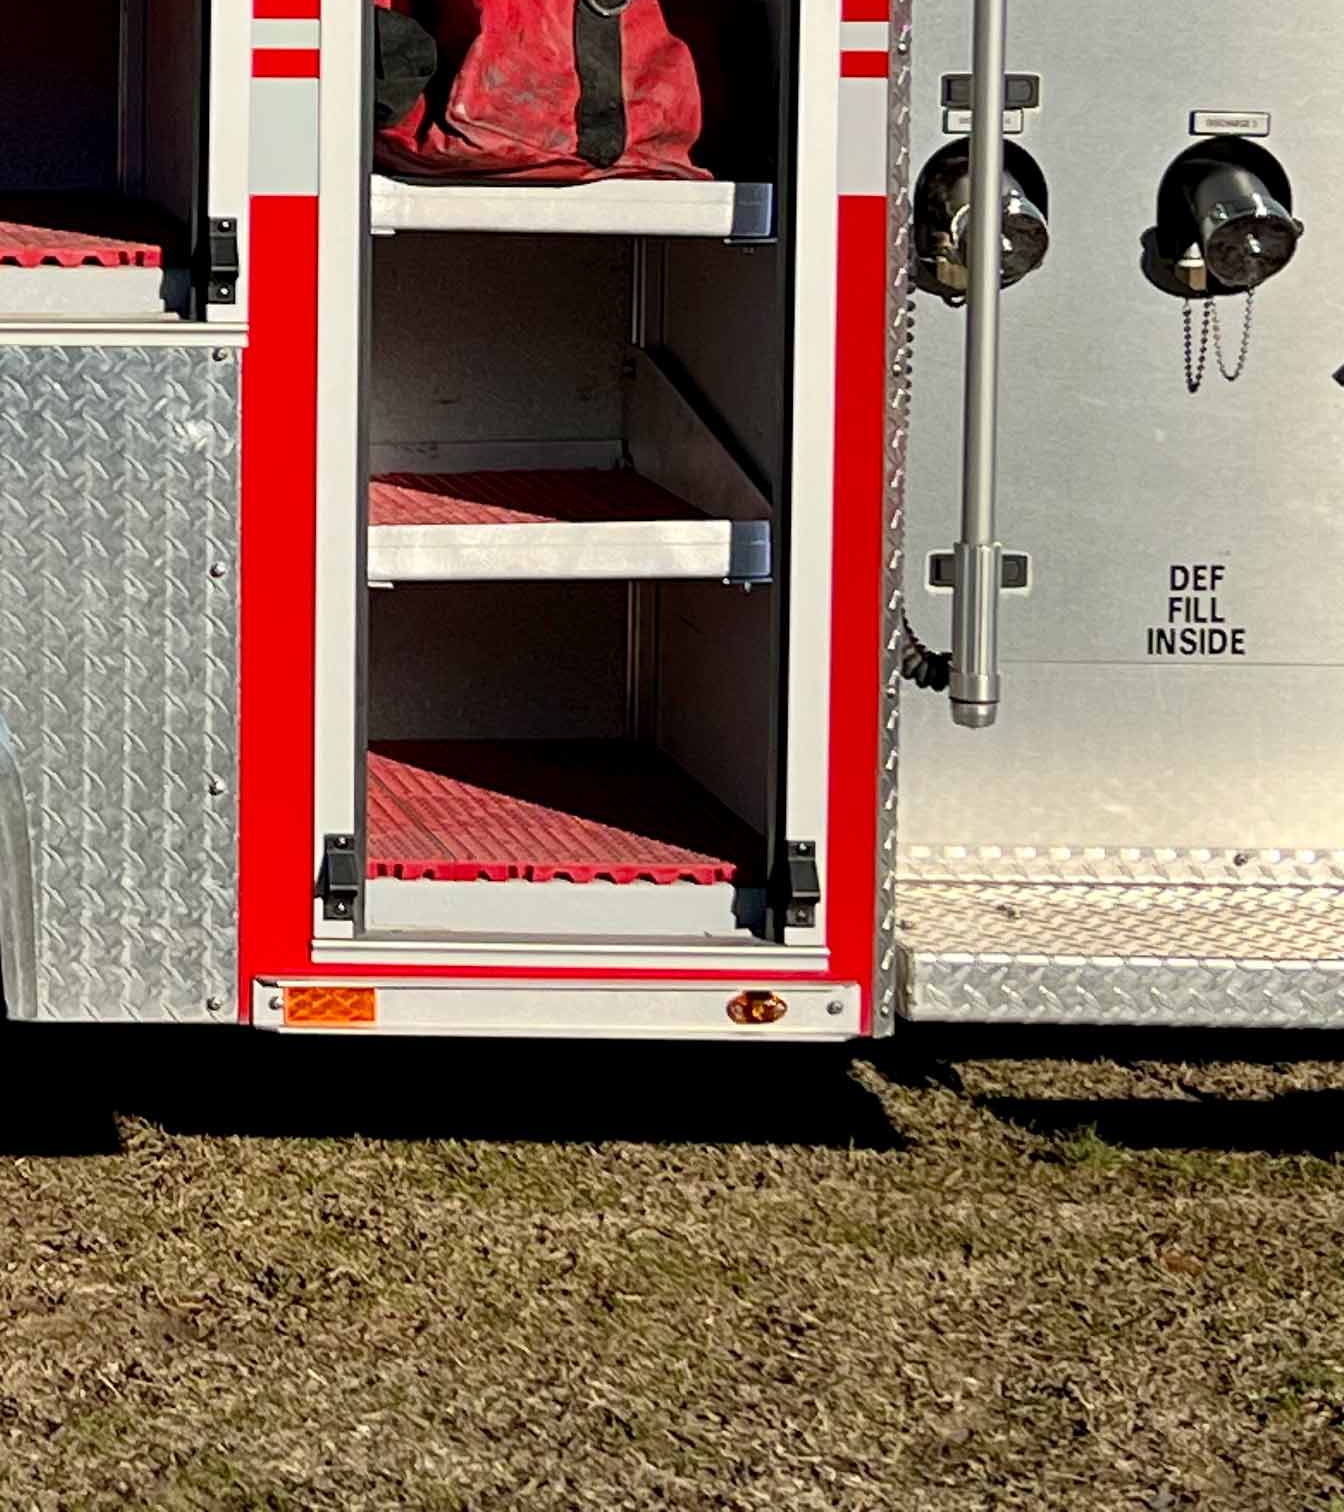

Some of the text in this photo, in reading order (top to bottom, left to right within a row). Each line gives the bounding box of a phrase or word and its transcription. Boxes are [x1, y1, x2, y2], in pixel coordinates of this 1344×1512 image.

[1169, 564, 1225, 591] DEF
[1168, 596, 1225, 623] FILL
[1147, 627, 1246, 655] INSIDE
